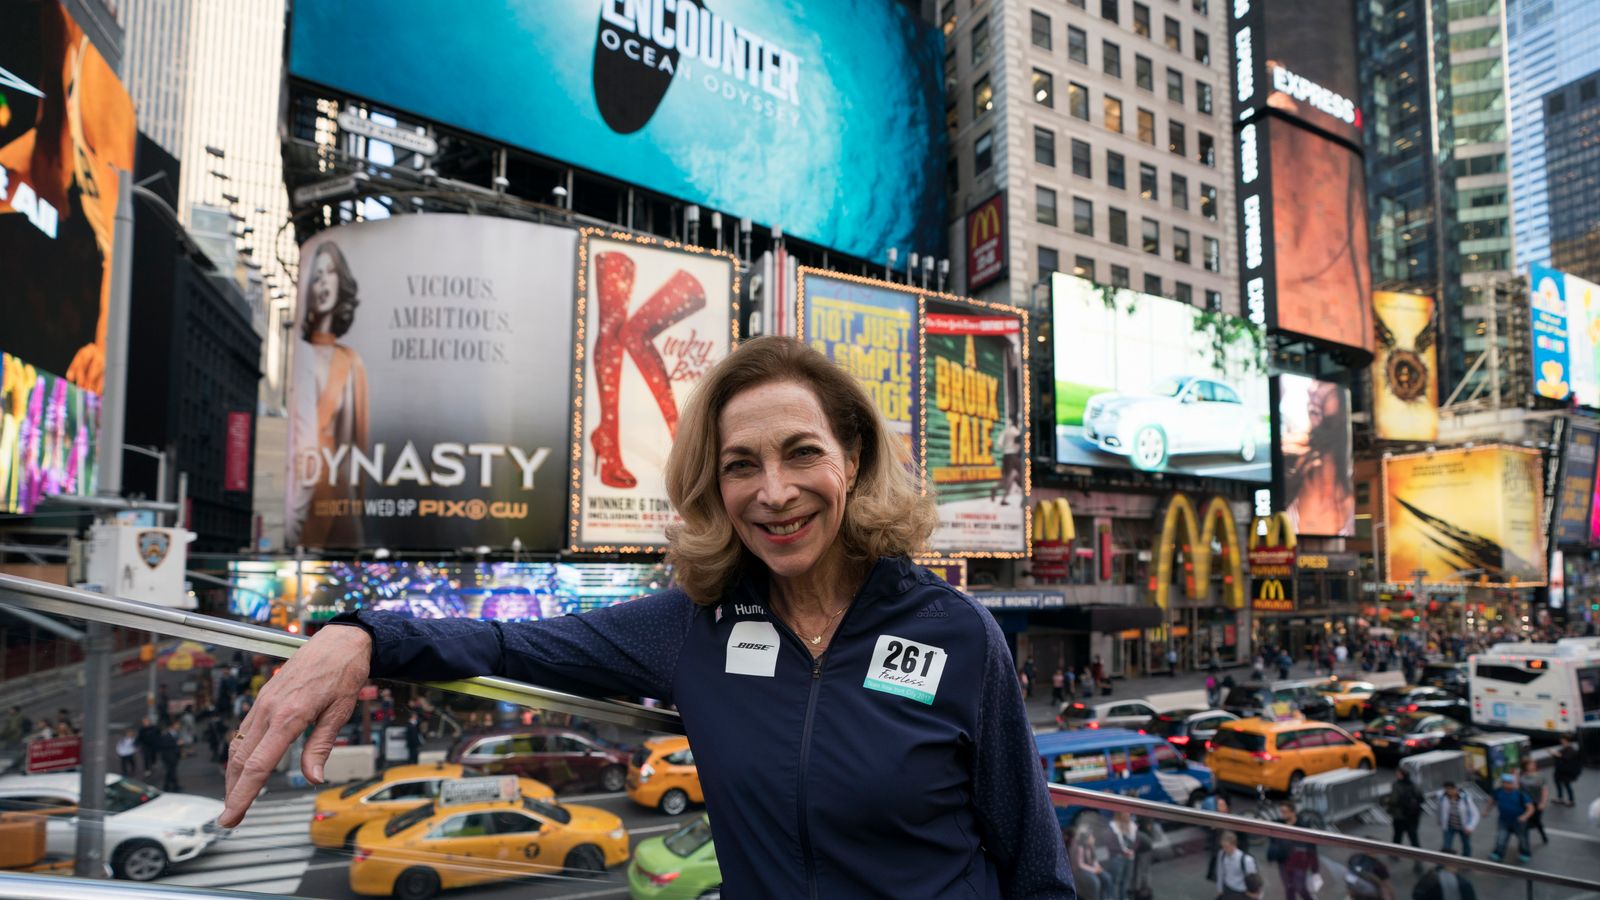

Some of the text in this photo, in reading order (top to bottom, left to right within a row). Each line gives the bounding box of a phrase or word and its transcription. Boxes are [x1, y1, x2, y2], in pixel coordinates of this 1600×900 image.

[601, 0, 801, 106] ENCOUNTER
[601, 28, 801, 129] OCEAN ODYSSEY
[1273, 65, 1355, 123] EXPRESS
[406, 274, 497, 300] VICIOUS.
[389, 306, 513, 333] AMBITIOUS.
[810, 305, 854, 345] NOT
[856, 314, 911, 352] JUST
[391, 337, 509, 364] DELICIOUS.
[833, 342, 912, 386] SIMPLE
[935, 354, 999, 420] BRONX
[946, 410, 996, 466] TALE
[298, 439, 550, 490] DYNASTY
[364, 499, 396, 517] WED
[397, 498, 417, 517] 9P
[489, 501, 528, 518] CW
[642, 512, 669, 521] BEST
[649, 499, 670, 512] TON
[916, 609, 949, 618] adidas
[735, 642, 772, 651] BOSE
[883, 641, 935, 678] 261
[878, 669, 926, 687] Fearless
